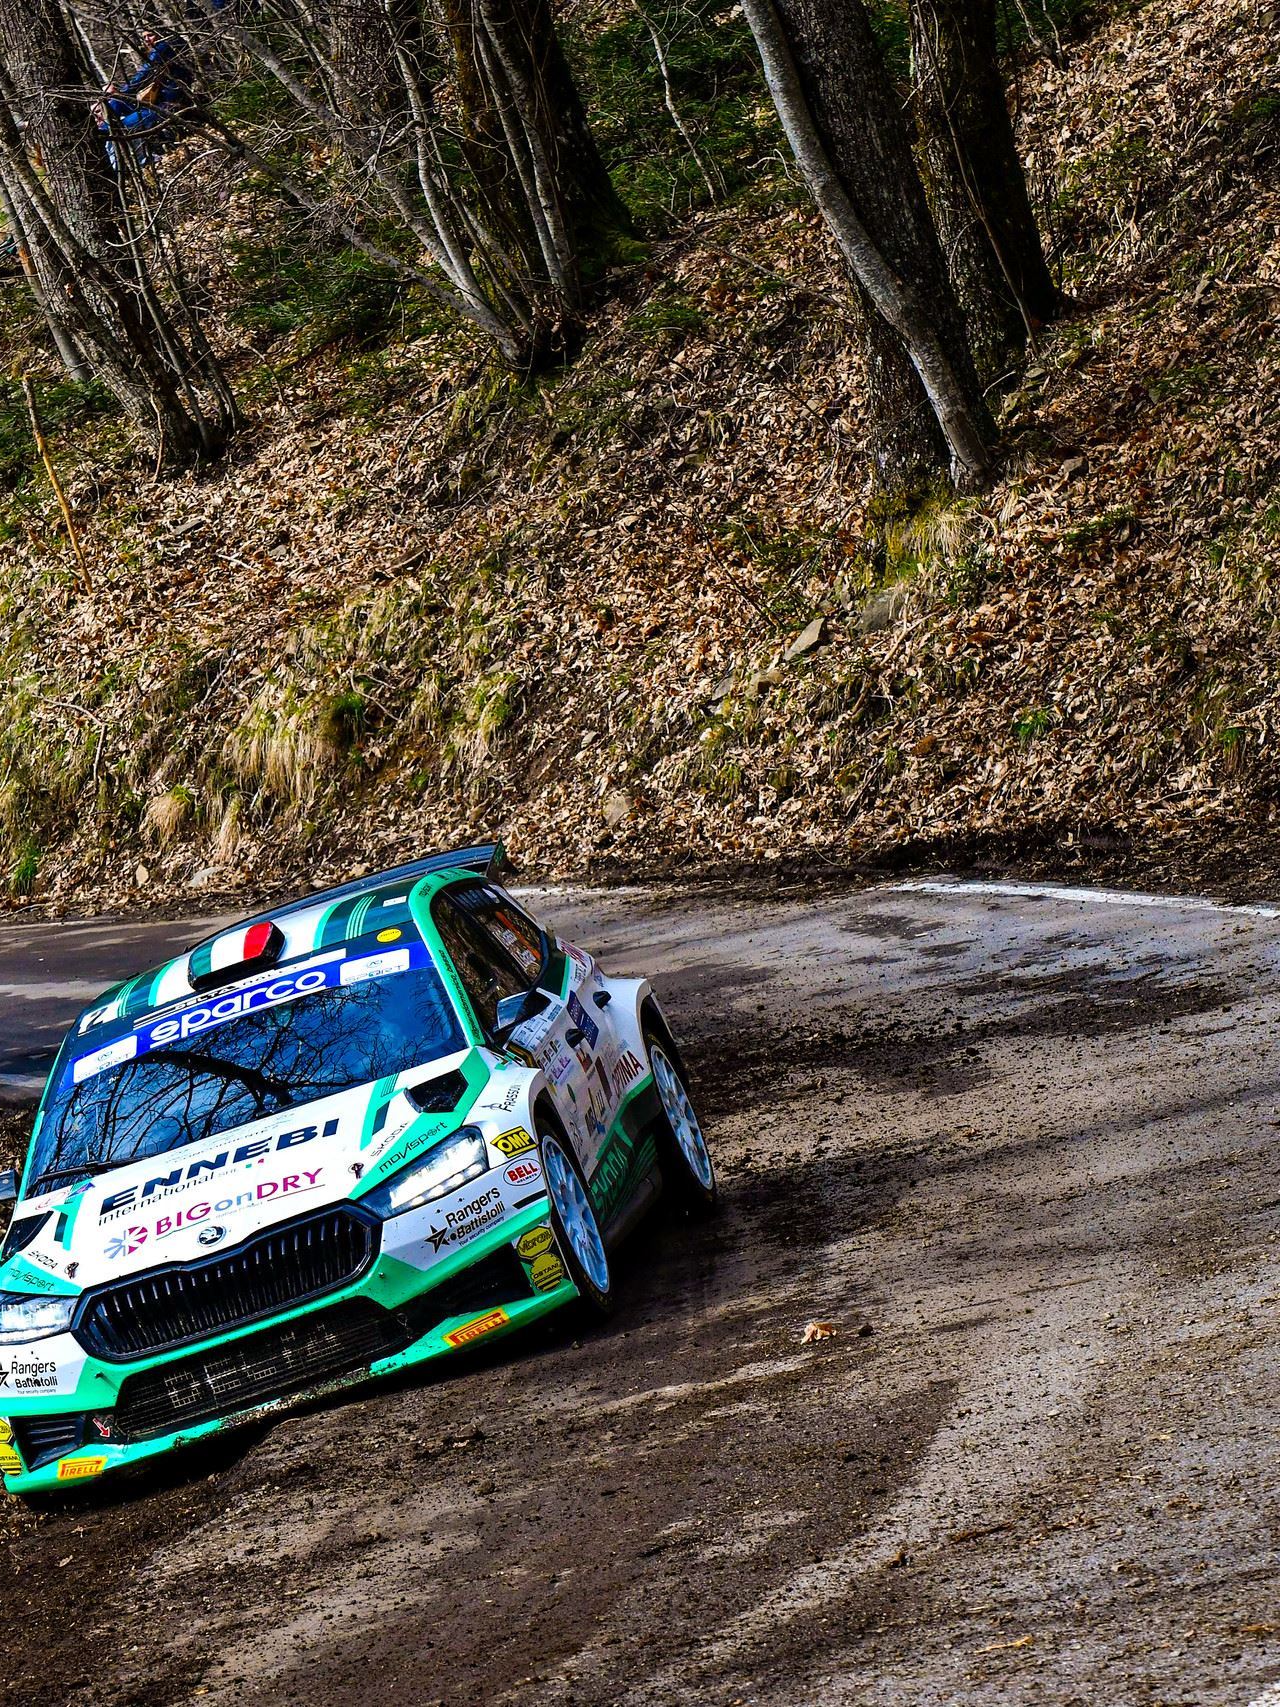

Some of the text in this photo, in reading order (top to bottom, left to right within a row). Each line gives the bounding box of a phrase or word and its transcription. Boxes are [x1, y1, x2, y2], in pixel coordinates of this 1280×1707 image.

[150, 971, 326, 1042] sparco
[496, 1130, 531, 1153] OMP
[99, 1118, 340, 1216] ENNEBI
[506, 1162, 539, 1182] BELL
[98, 1171, 214, 1227] international
[155, 1168, 324, 1236] BIGonDRY
[445, 1187, 501, 1228] Rangers
[456, 1201, 506, 1239] Battistolli
[533, 1263, 559, 1279] OSTANI
[449, 1312, 506, 1345] PIRELLI
[11, 1361, 56, 1377] Rangers
[60, 1460, 102, 1478] PIRELLI
